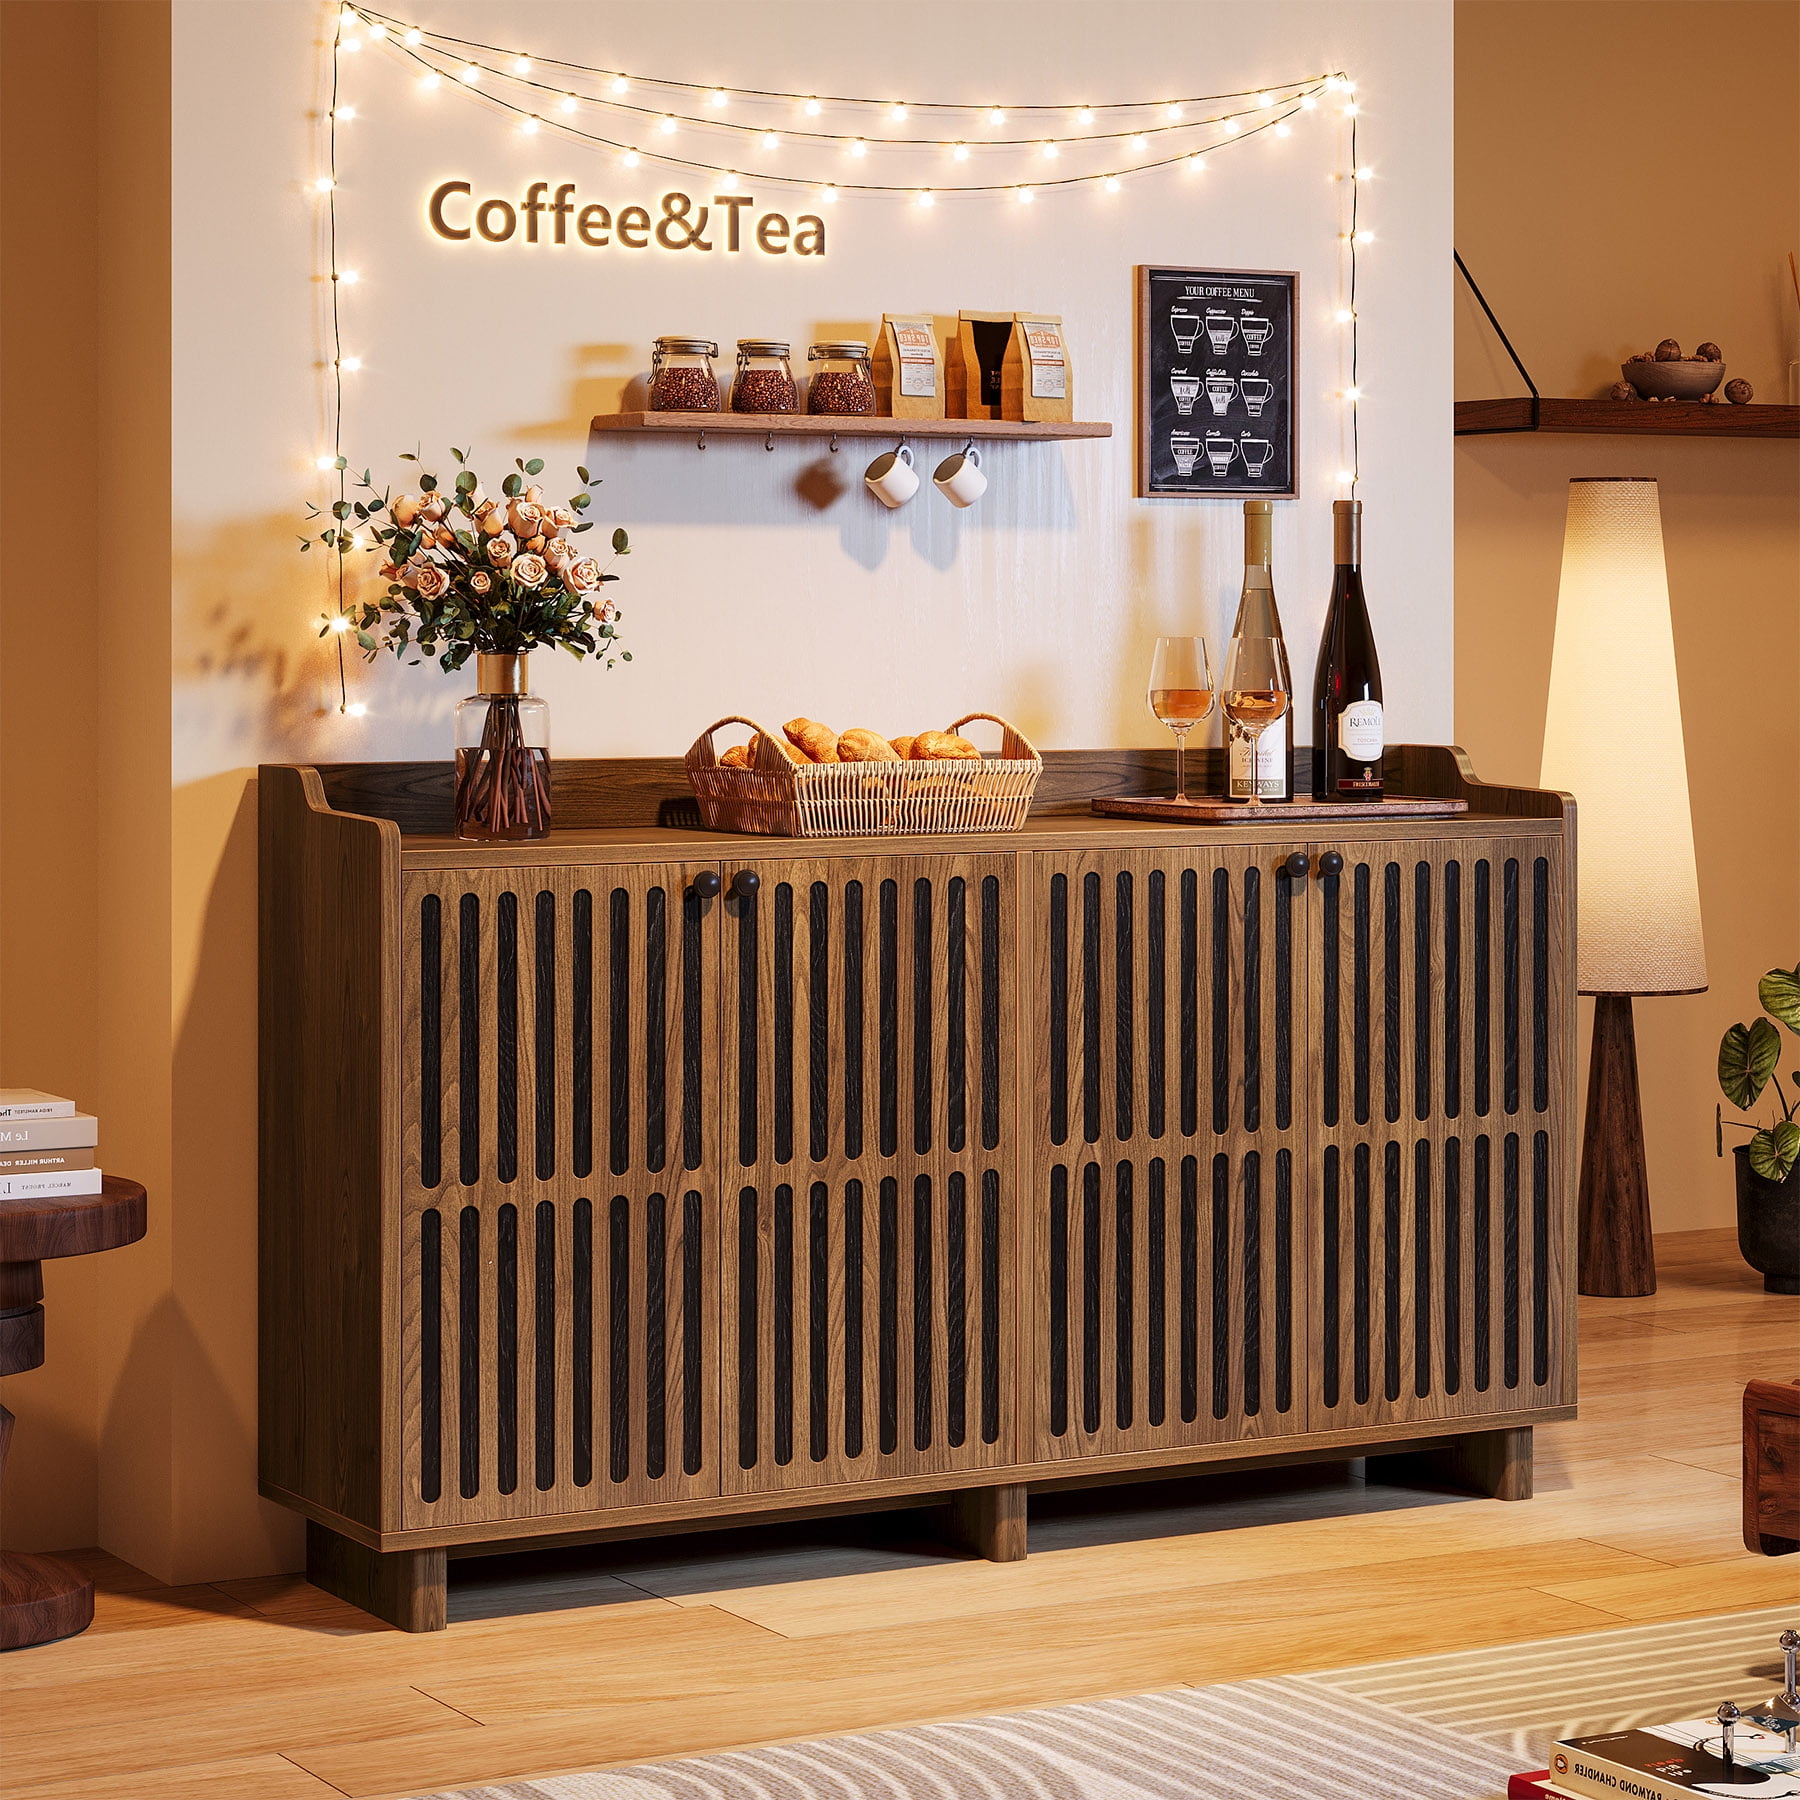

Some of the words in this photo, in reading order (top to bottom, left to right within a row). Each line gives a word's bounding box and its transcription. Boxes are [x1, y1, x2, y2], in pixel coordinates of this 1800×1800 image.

[428, 181, 826, 256] Coffee&Tea
[1185, 286, 1204, 296] YOUR
[1205, 287, 1232, 297] COFFEE
[1233, 288, 1255, 298] MENU
